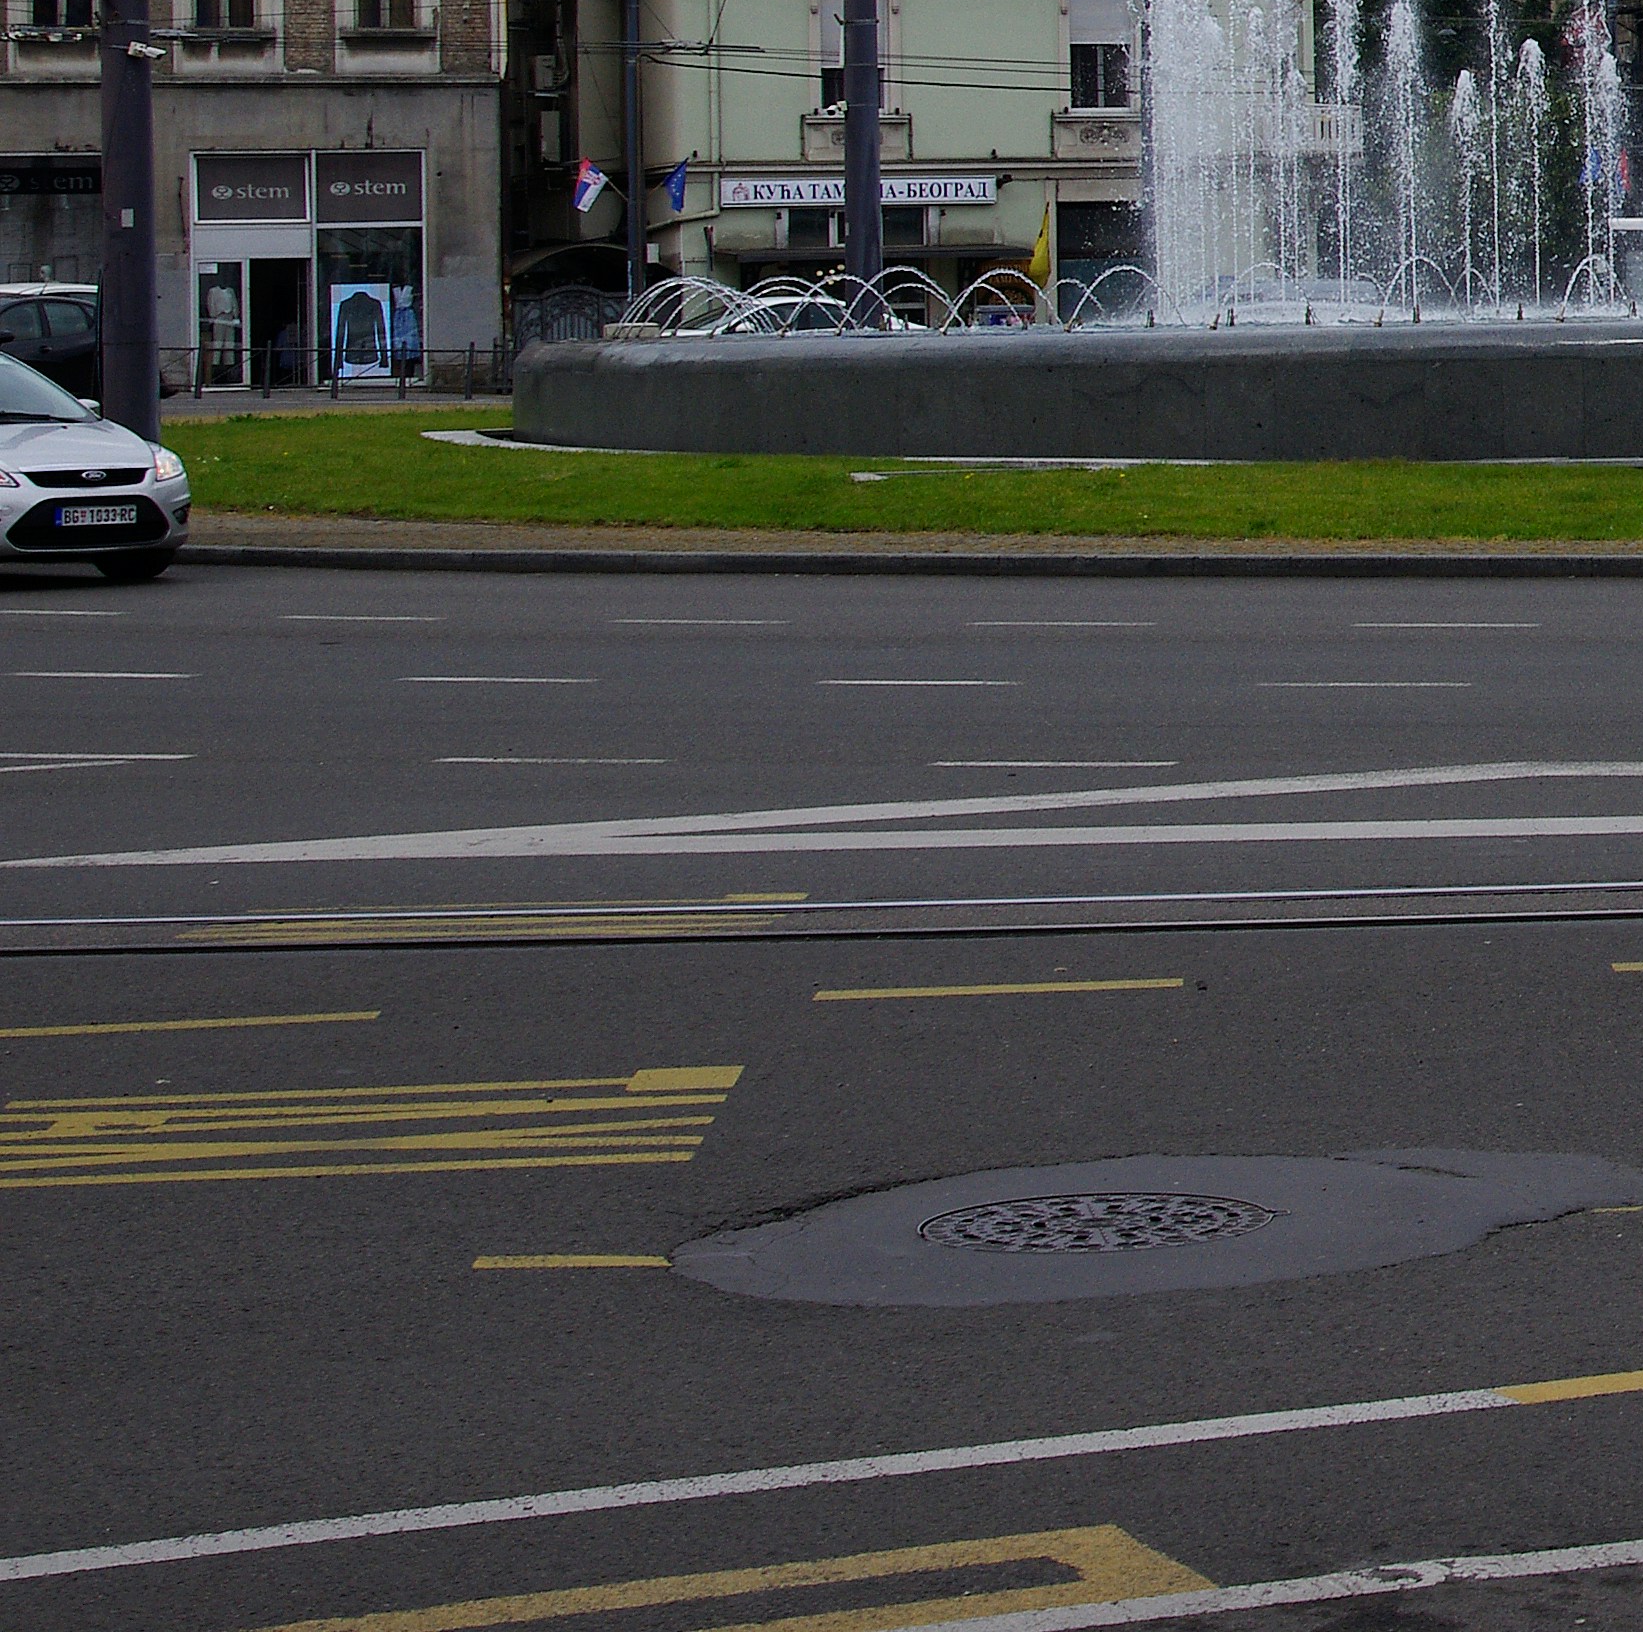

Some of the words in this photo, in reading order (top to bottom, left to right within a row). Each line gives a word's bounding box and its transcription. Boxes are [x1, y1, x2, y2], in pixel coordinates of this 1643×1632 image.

[236, 183, 290, 199] stem
[354, 180, 407, 196] stem
[753, 183, 805, 201] КУЋА
[64, 509, 79, 525] BG
